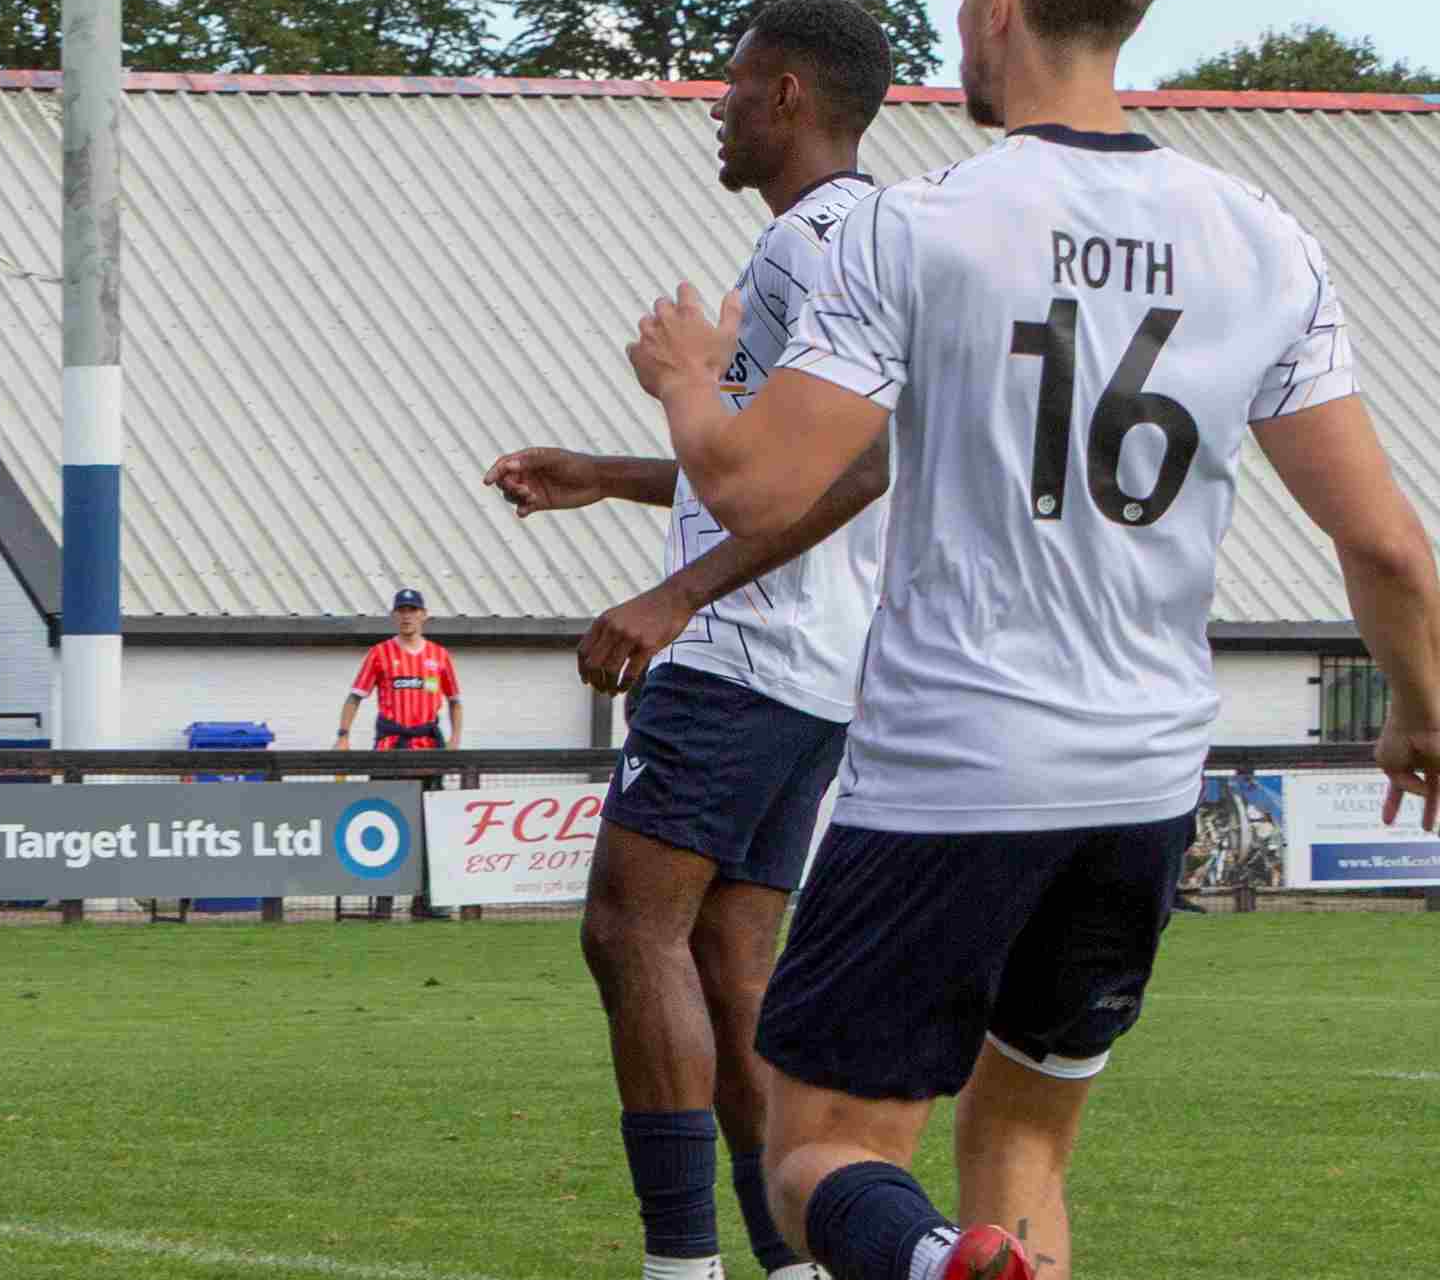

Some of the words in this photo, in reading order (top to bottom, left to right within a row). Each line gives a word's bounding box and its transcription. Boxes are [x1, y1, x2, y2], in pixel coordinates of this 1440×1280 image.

[1051, 229, 1173, 295] ROTH
[1009, 297, 1199, 527] 16
[147, 819, 242, 858] Lifts
[252, 819, 322, 857] Ltd
[465, 852, 520, 874] EST
